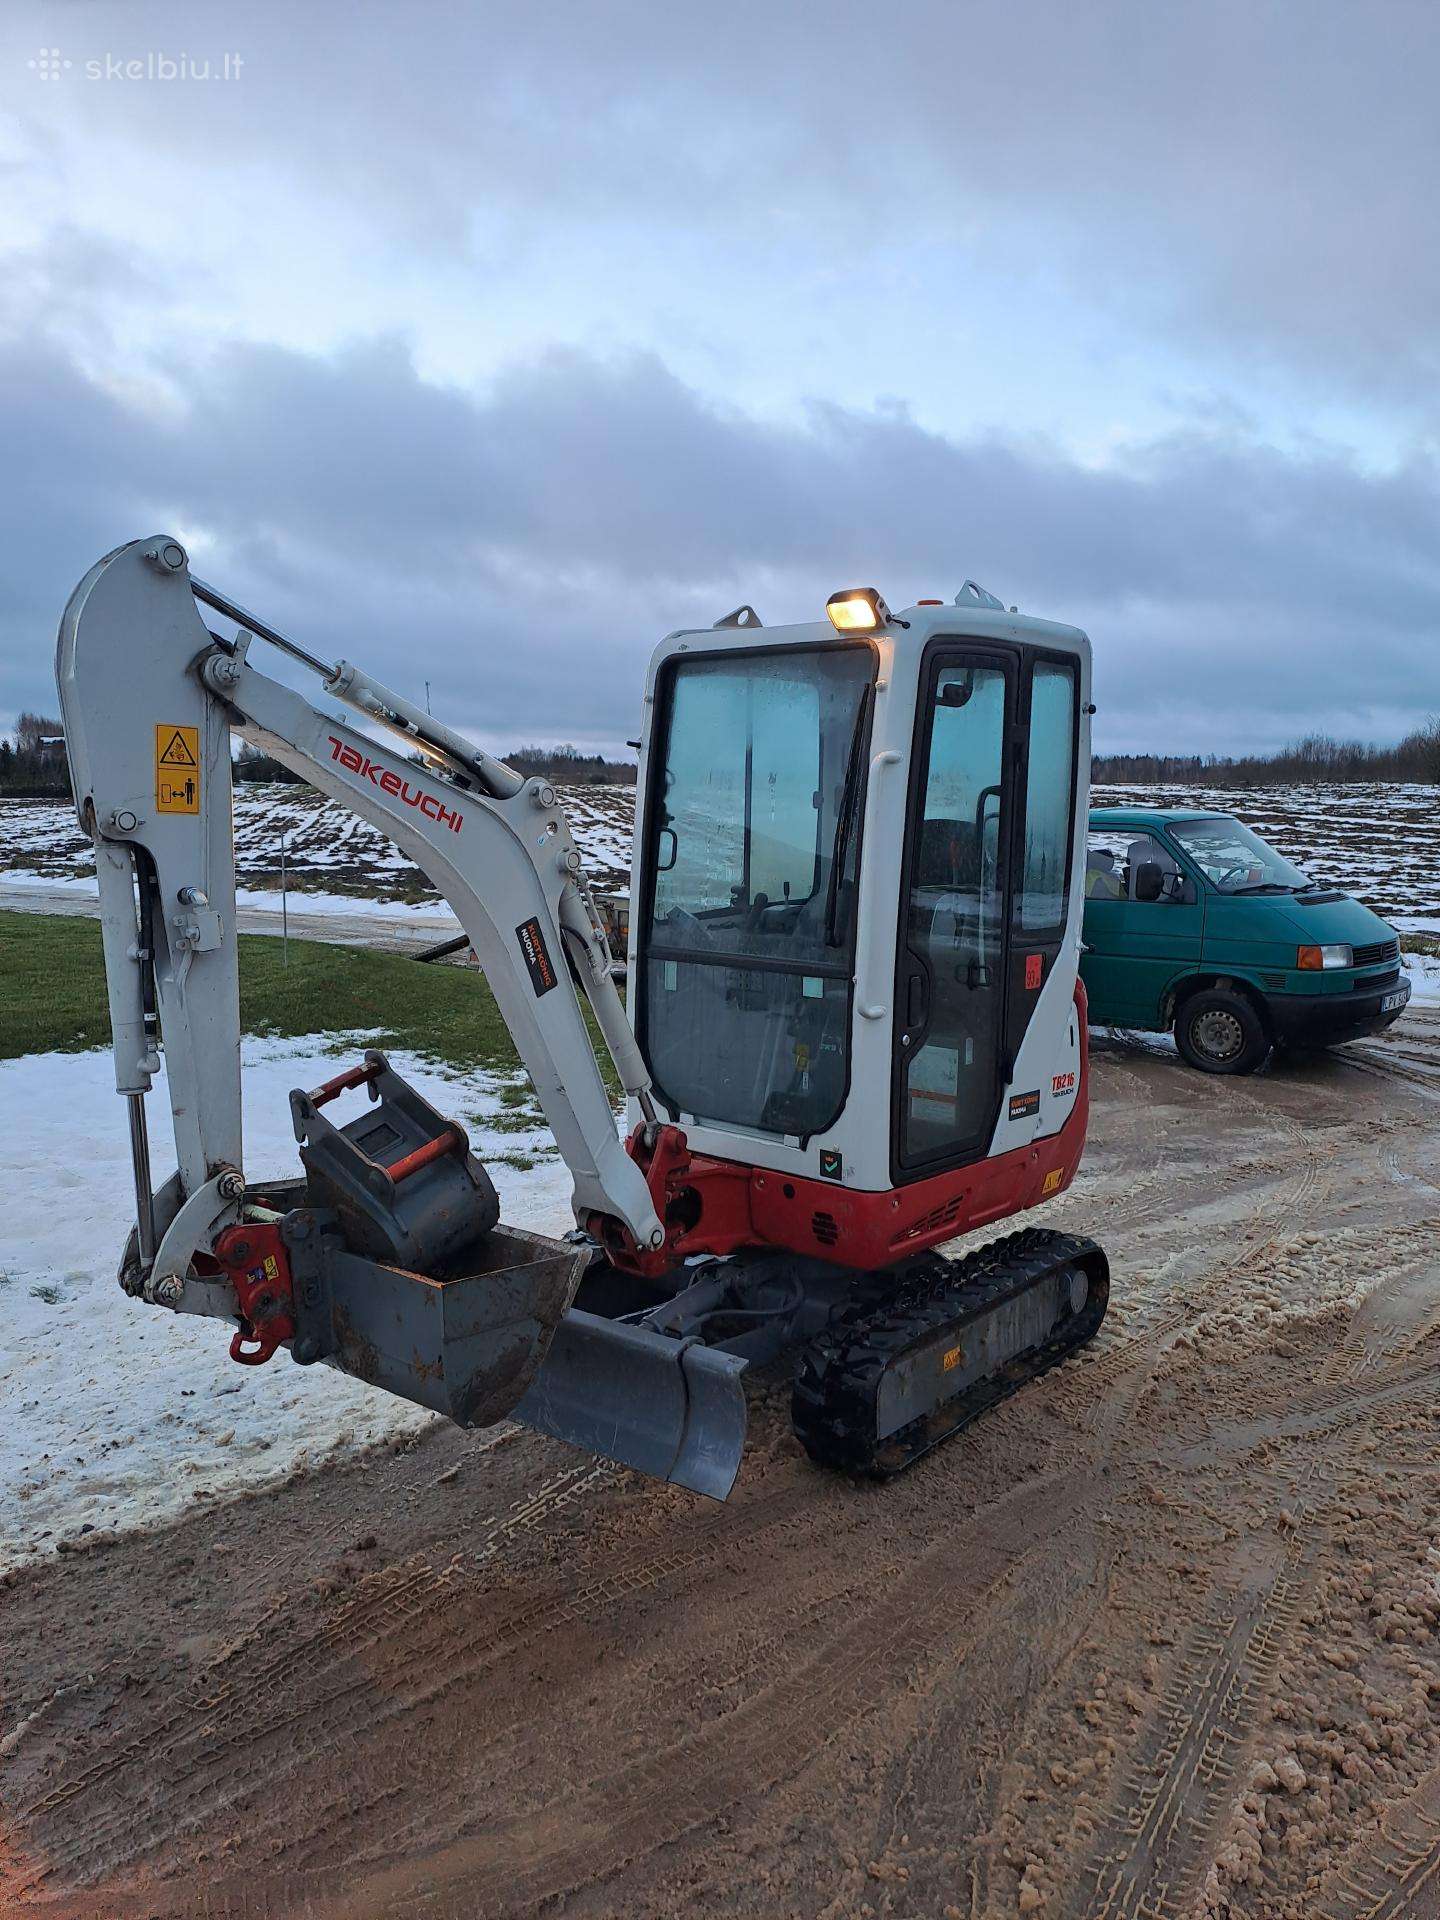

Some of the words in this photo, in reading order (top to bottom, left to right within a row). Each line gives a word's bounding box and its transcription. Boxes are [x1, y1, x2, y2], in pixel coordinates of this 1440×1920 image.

[327, 735, 464, 834] TAKEUCHI
[520, 928, 537, 966] NUOMA
[527, 923, 542, 953] KURT
[537, 952, 552, 987] KÖNIG
[1052, 1072, 1075, 1092] TB216
